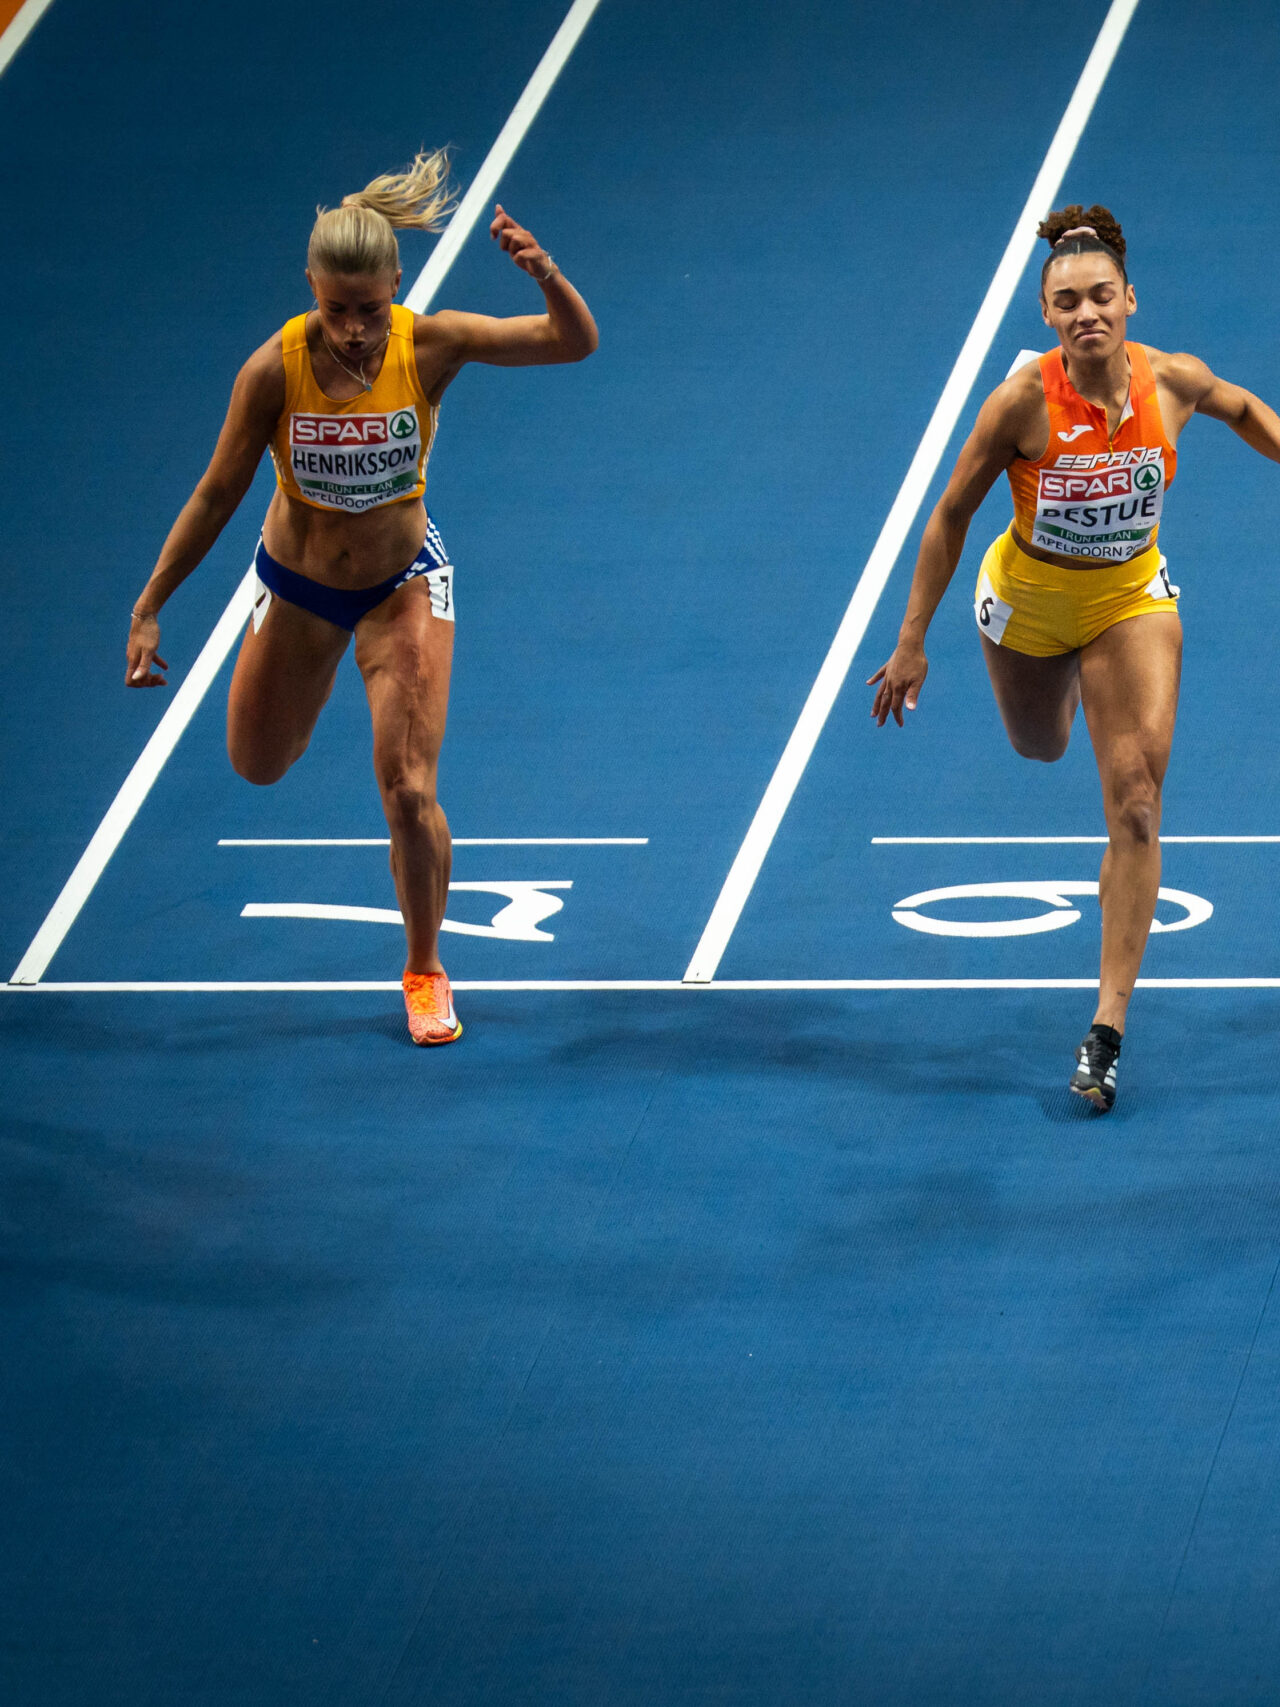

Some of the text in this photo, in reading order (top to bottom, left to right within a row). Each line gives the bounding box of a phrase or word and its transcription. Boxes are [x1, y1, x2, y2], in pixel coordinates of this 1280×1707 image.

[296, 420, 386, 442] SPAR
[293, 444, 417, 476] HENRIKSSON
[1054, 446, 1163, 469] ESPAÑA
[328, 482, 352, 494] RUN
[1043, 471, 1130, 498] SPAR
[1037, 534, 1122, 557] APELDOORN
[1067, 531, 1091, 542] RUN
[980, 597, 994, 626] 6
[891, 880, 1214, 937] 6
